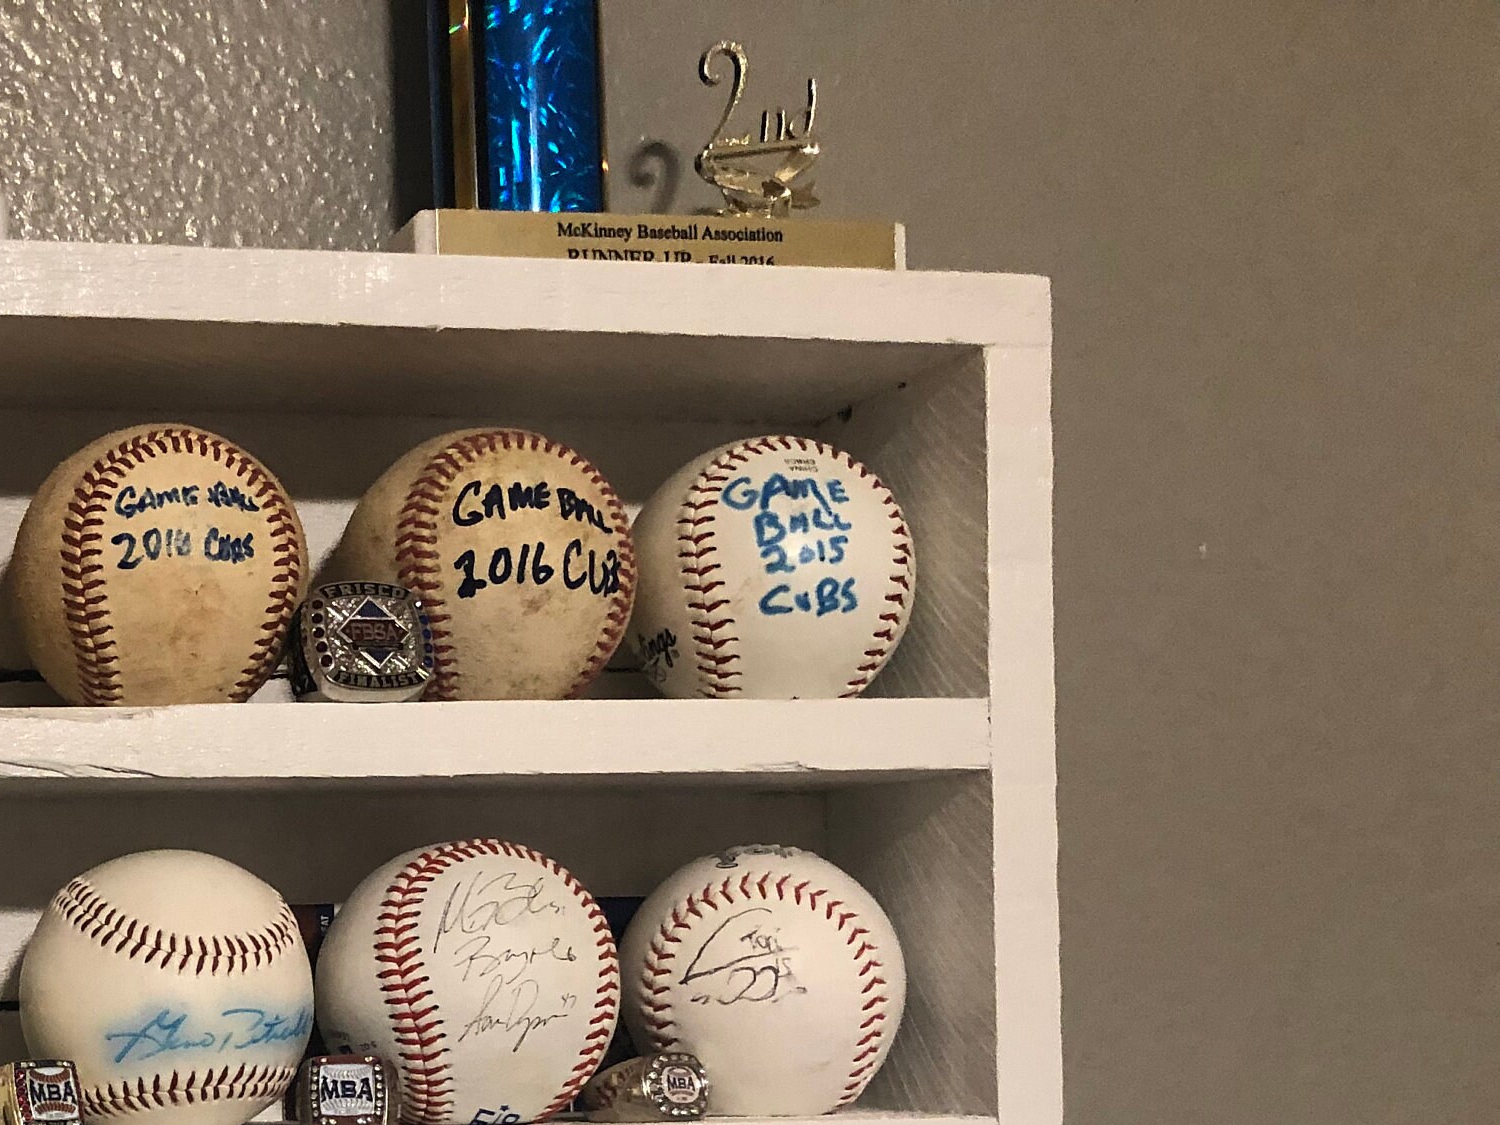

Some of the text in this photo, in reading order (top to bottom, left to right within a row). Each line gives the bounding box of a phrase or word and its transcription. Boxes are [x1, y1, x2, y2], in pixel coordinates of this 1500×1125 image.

[557, 222, 784, 243] McKinney Baseball Association
[113, 484, 200, 519] GAME
[452, 479, 551, 527] GAME
[720, 472, 851, 515] GAME
[753, 507, 852, 549] BALL
[453, 541, 555, 600] 2016
[758, 534, 850, 575] 2015
[324, 583, 407, 600] FRISCO
[757, 576, 859, 618] CUBS
[350, 622, 399, 641] FBSA
[28, 1077, 78, 1107] MBA
[320, 1075, 375, 1103] MBA
[667, 1073, 696, 1092] MBA
